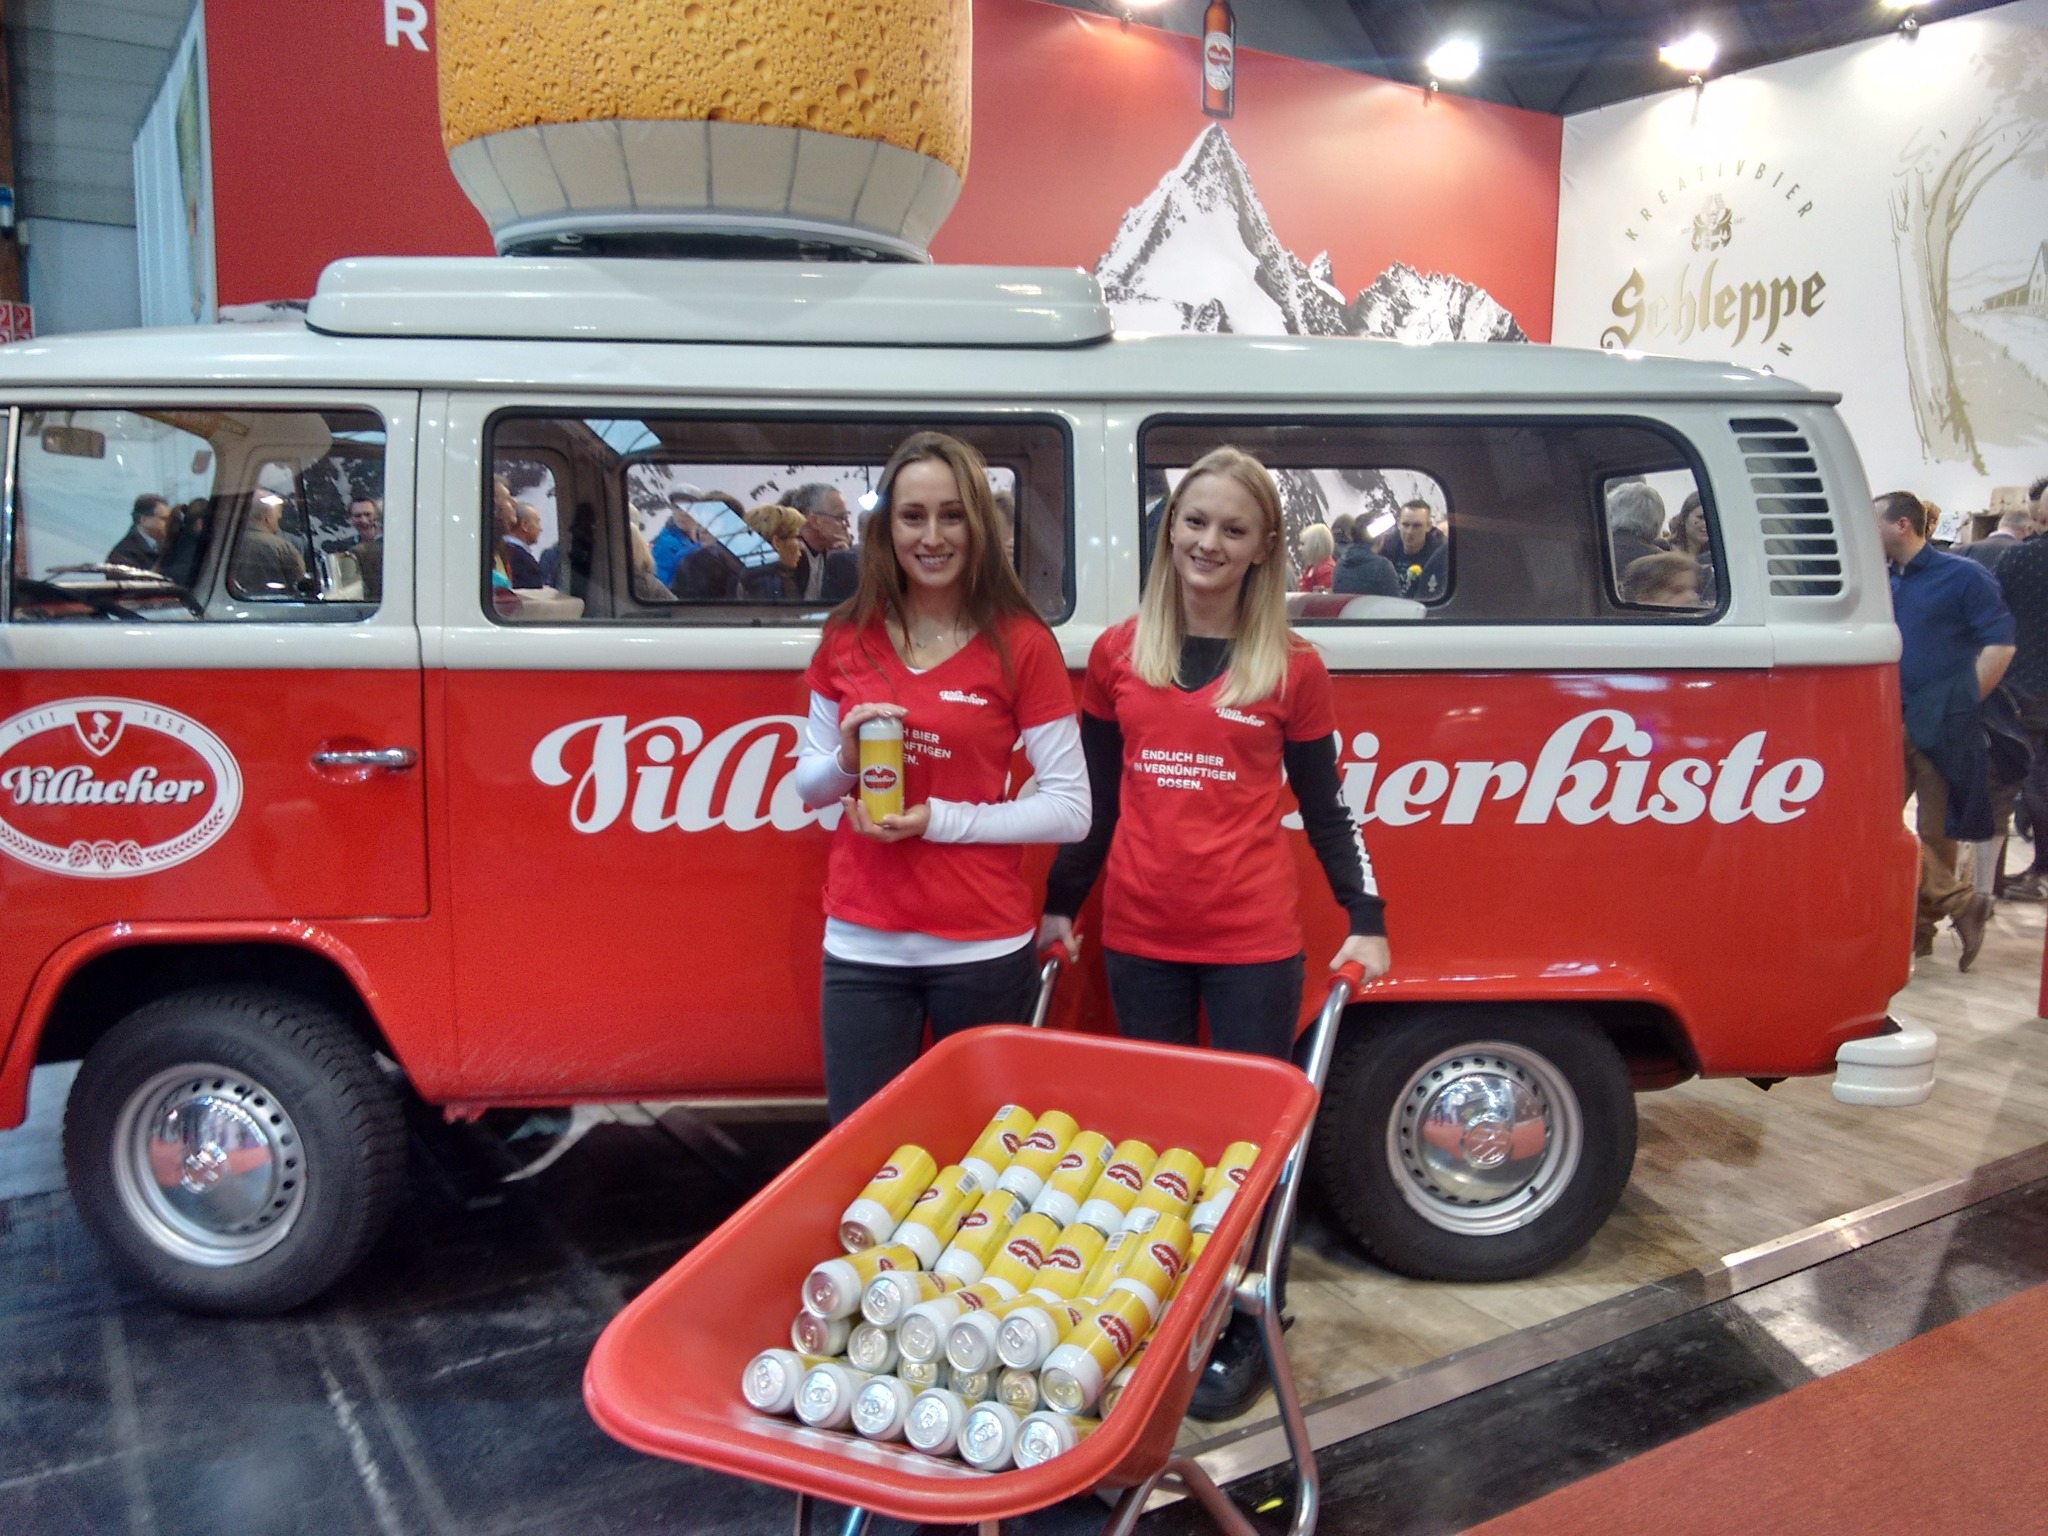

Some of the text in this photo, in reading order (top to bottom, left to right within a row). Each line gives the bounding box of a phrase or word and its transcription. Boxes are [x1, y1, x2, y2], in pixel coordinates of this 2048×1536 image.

[1625, 160, 1813, 241] KREATIVBIER
[1601, 258, 1826, 349] Schleppe
[15, 711, 57, 735] SEIT
[912, 730, 940, 744] BIER
[903, 742, 951, 758] NFTIGEN
[1141, 749, 1224, 767] ENDLICH BIER
[530, 714, 845, 833] Villa
[1143, 762, 1236, 781] VERNÜNFTIGEN
[1, 765, 206, 807] Villacher
[1157, 777, 1203, 791] DOSEN.
